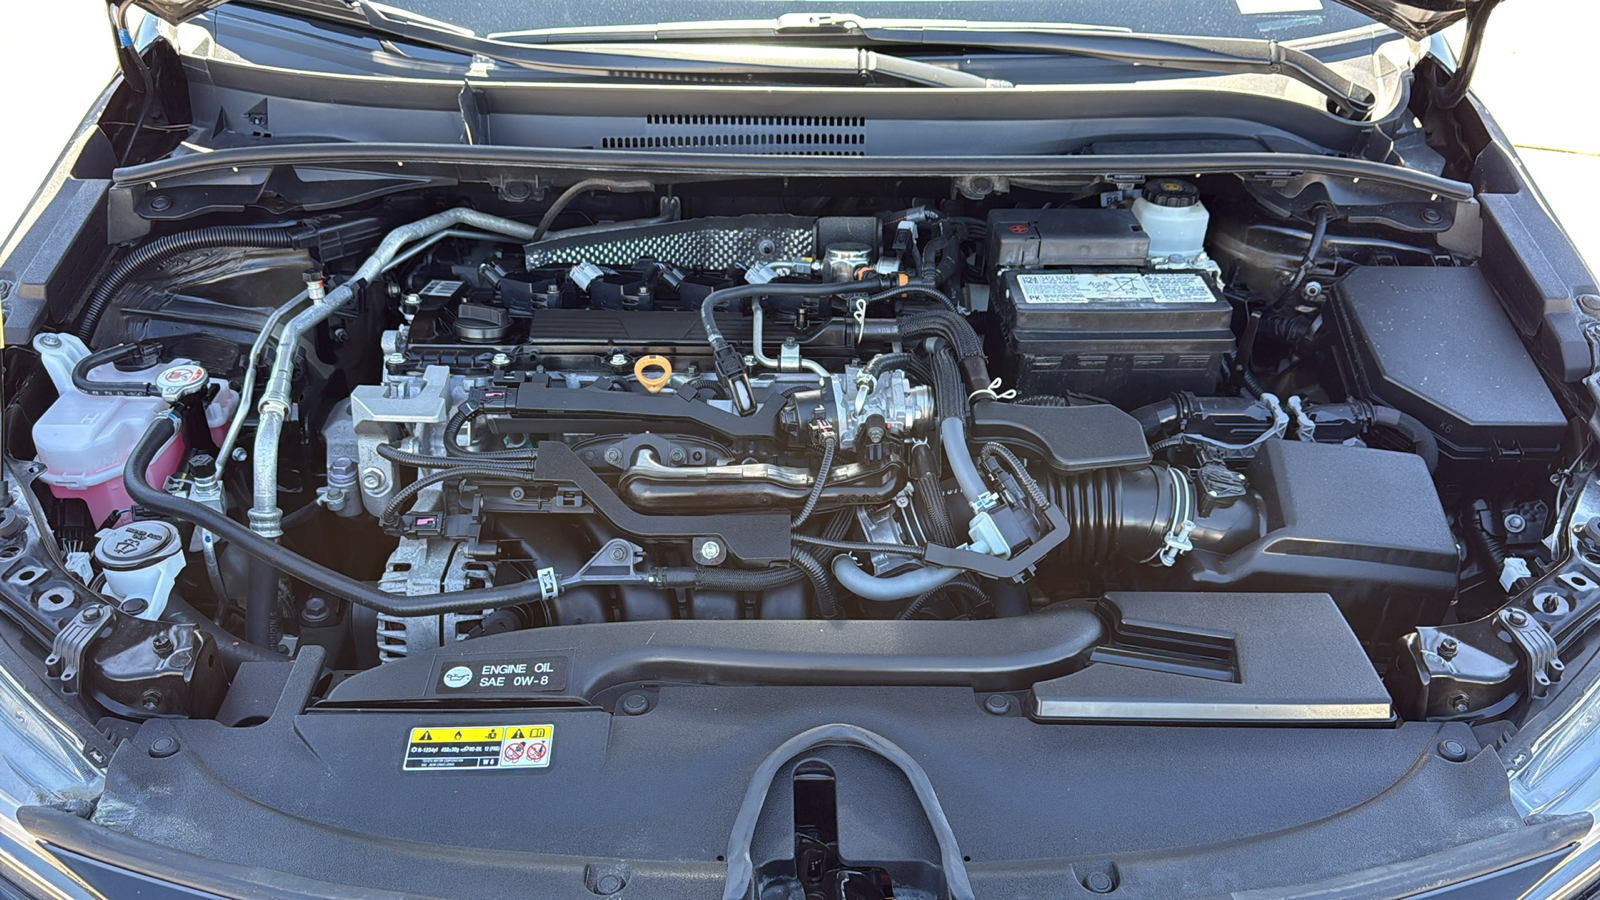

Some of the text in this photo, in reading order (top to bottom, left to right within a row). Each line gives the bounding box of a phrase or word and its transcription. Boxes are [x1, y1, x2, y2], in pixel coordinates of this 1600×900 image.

[80, 412, 99, 424] H
[481, 662, 554, 675] ENGINE OIL
[479, 675, 549, 687] SAE 0W-8
